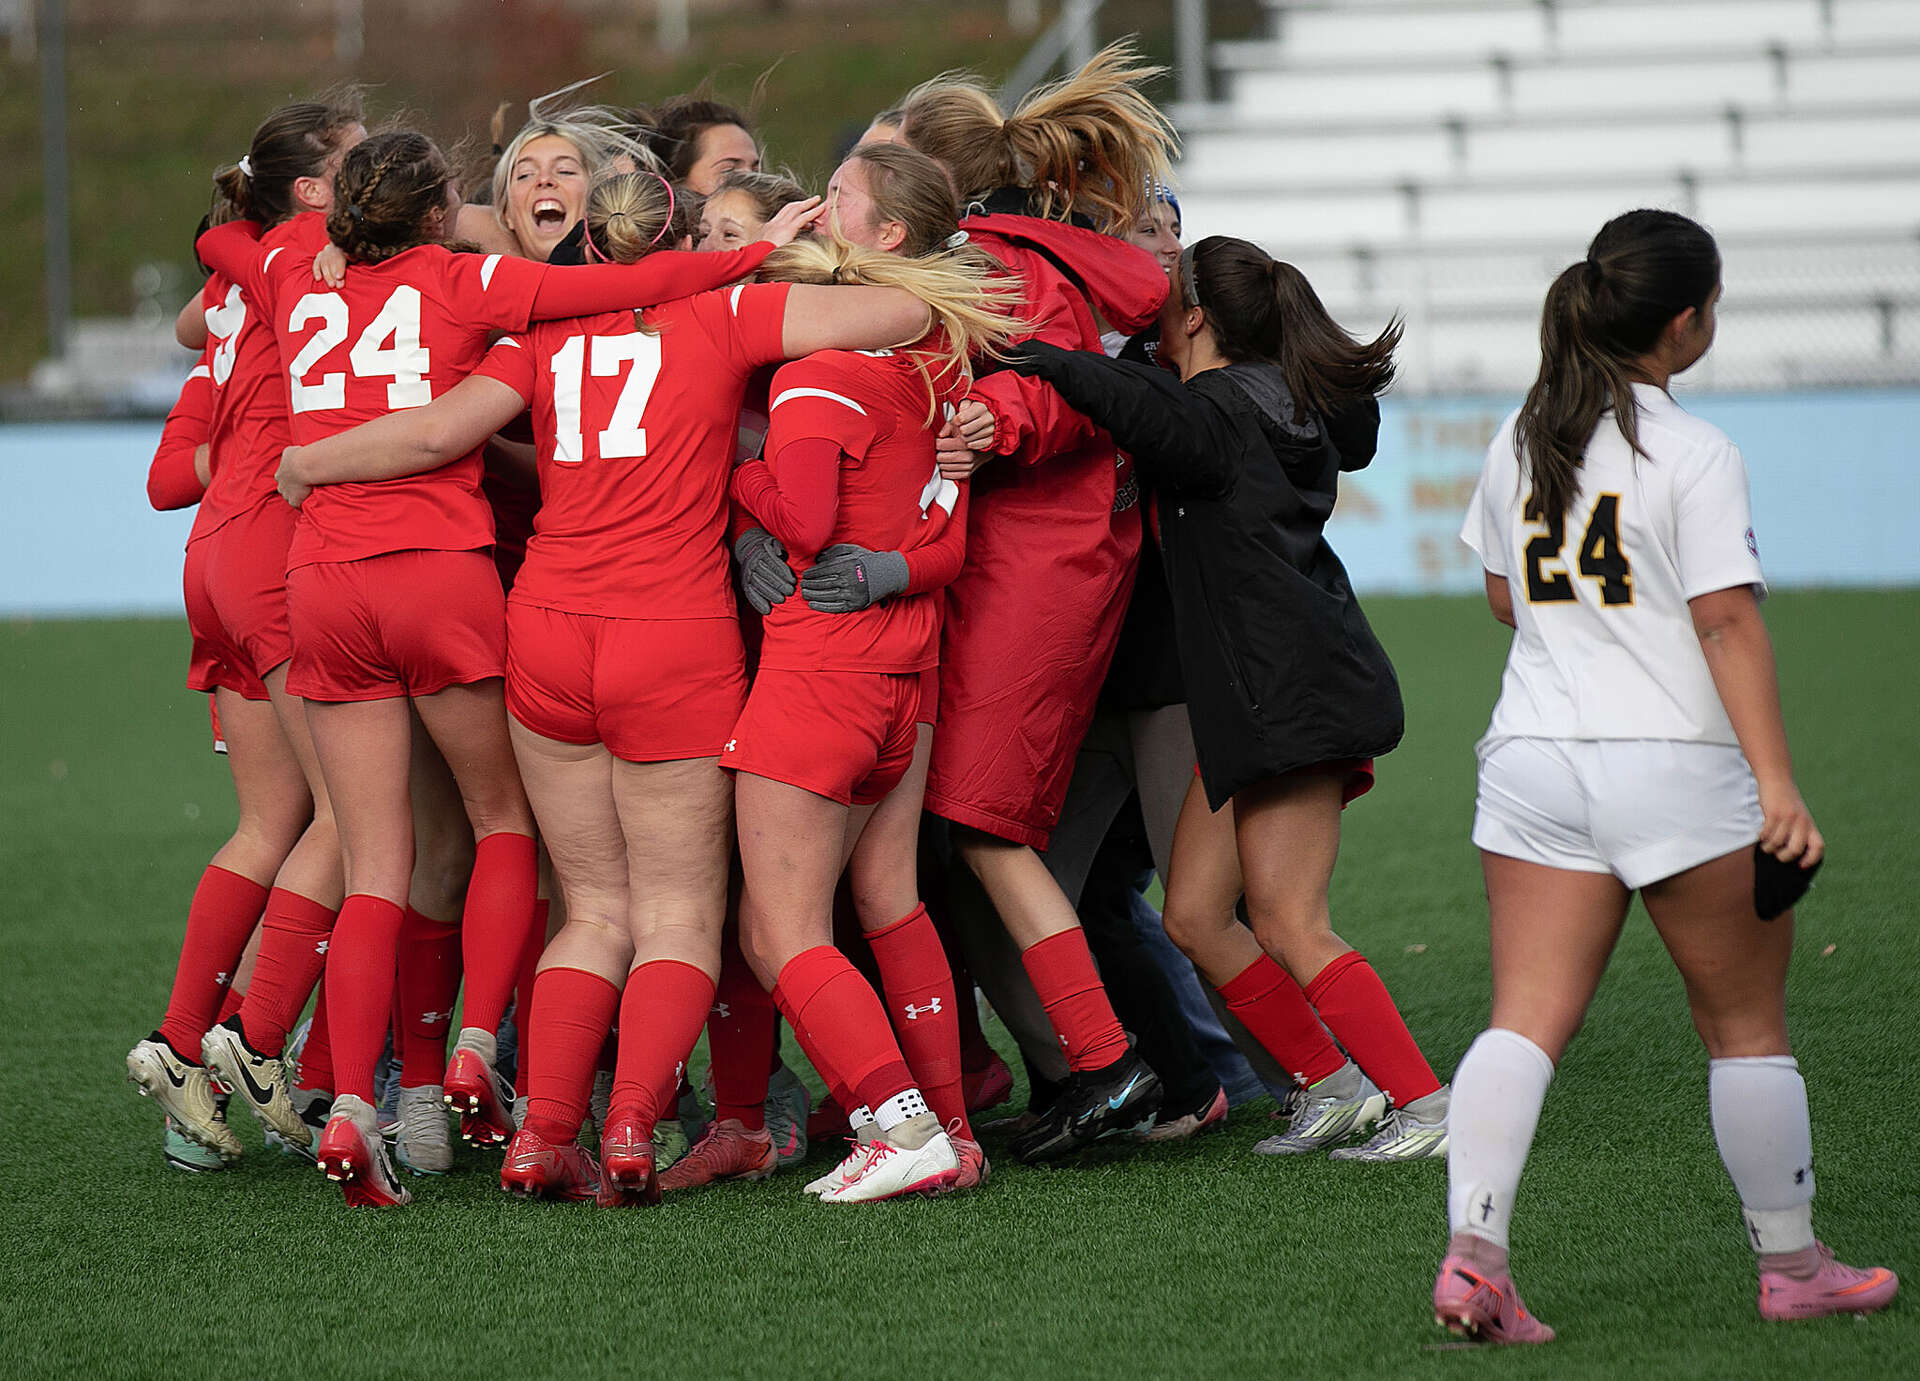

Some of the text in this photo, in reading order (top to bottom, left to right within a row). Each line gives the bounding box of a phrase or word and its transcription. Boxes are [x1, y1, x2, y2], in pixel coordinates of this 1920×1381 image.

[288, 284, 432, 414] 24
[550, 331, 662, 462] 17
[1522, 491, 1635, 608] 24
